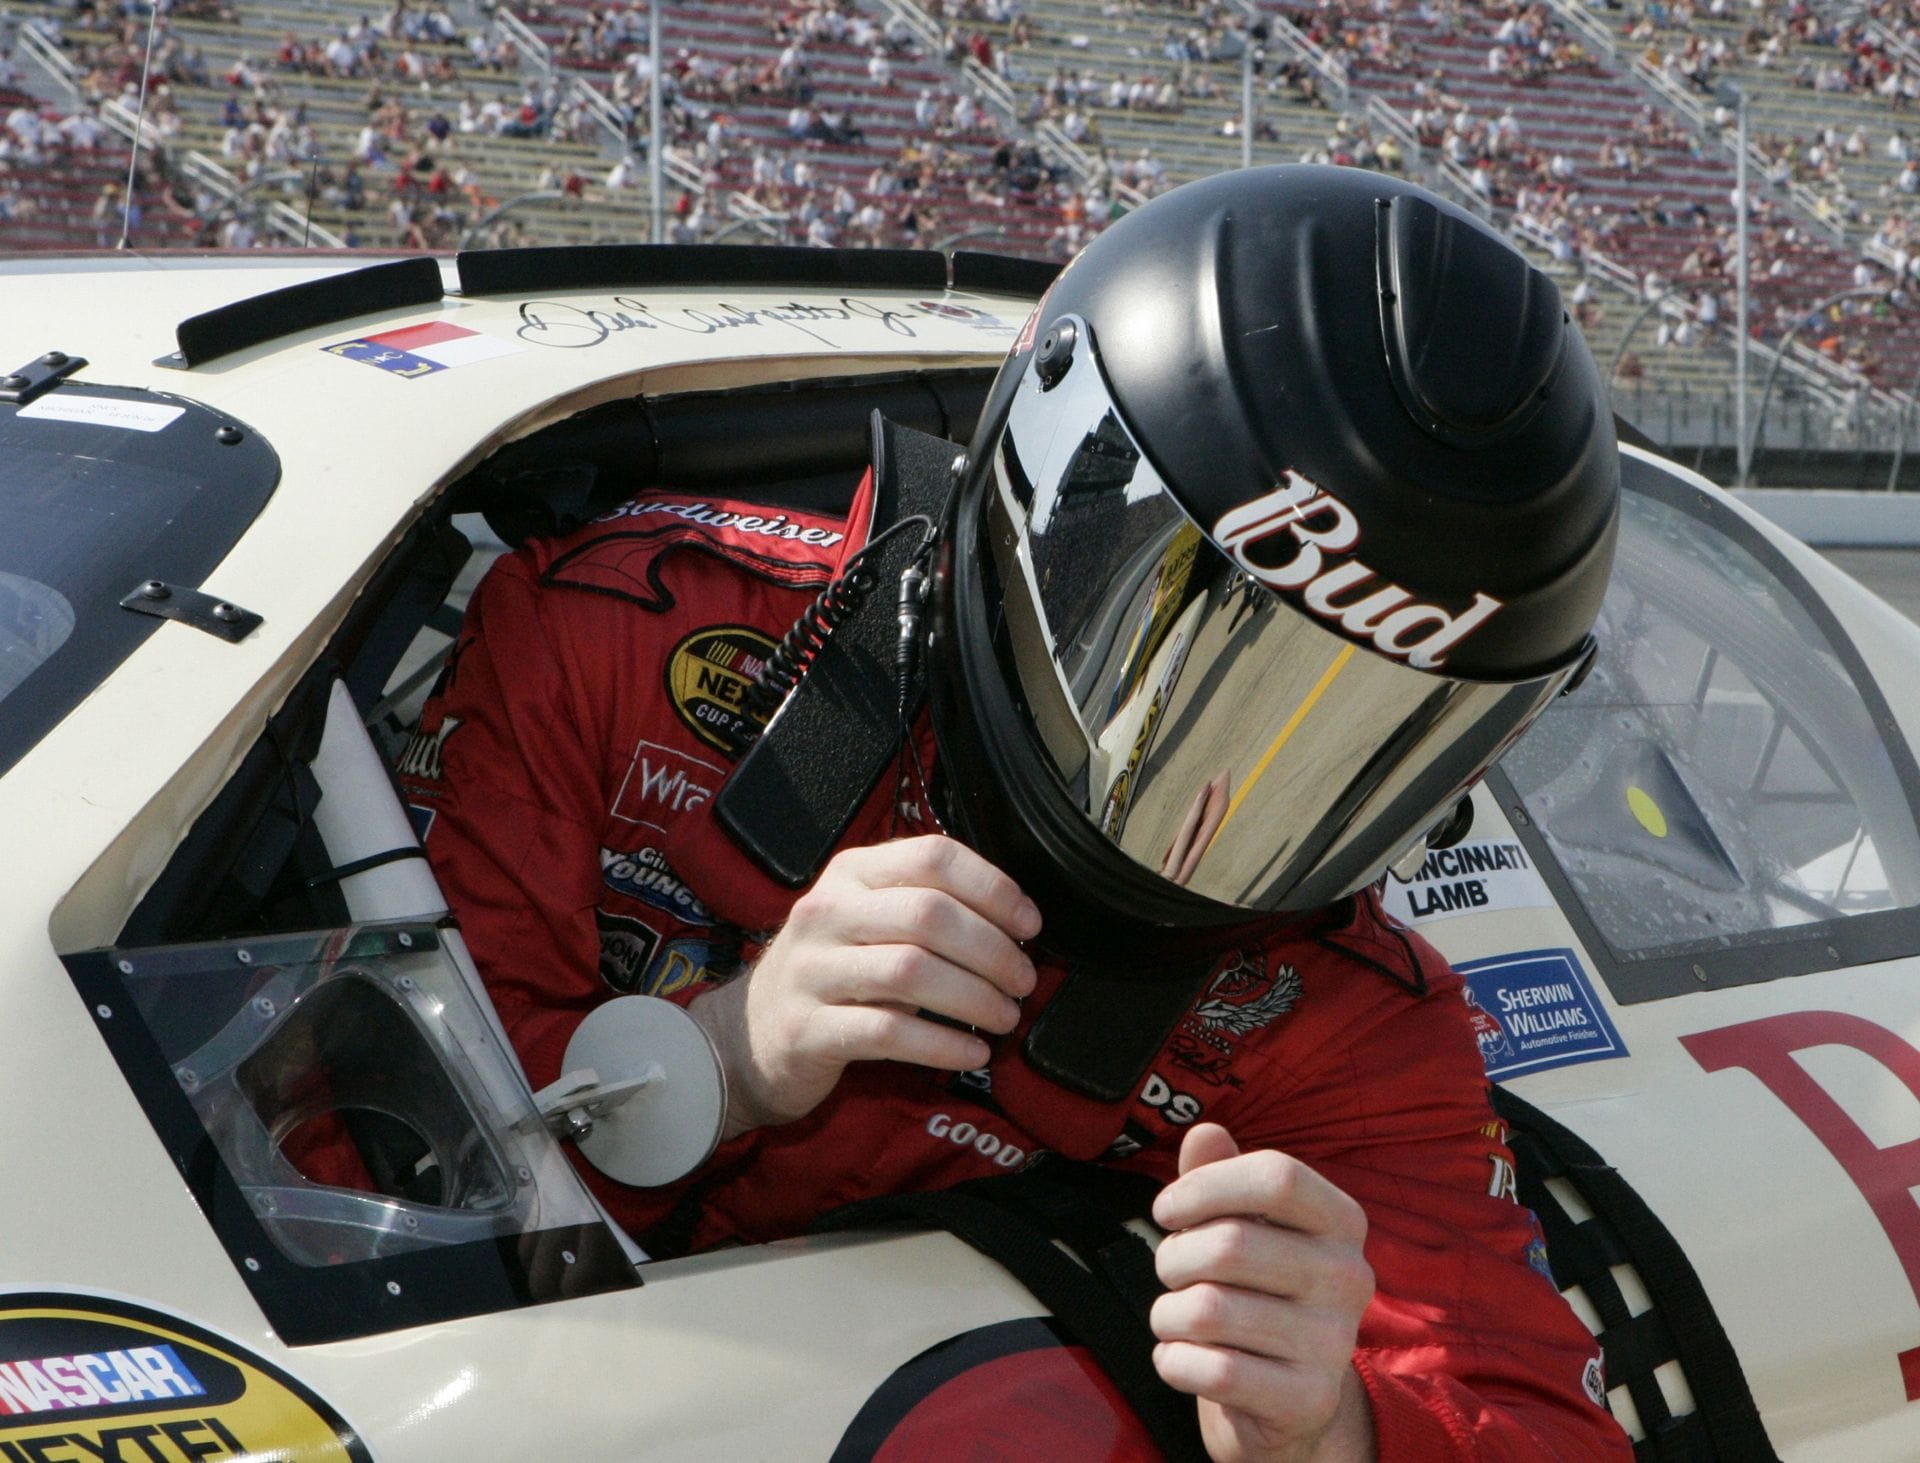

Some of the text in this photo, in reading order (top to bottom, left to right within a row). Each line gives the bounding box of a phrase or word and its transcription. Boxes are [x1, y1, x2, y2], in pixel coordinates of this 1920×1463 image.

[1213, 465, 1504, 674] Bud
[696, 704, 730, 727] CUP
[601, 848, 694, 905] YOUNG
[1412, 845, 1528, 882] NCINNATI
[1407, 880, 1489, 918] LAMB
[1497, 983, 1575, 1012] SHERWIN
[1505, 1007, 1588, 1037] WILLIAMS
[1521, 1029, 1598, 1051] Automotive Finishes
[926, 1113, 1025, 1168] GOOD
[0, 1346, 194, 1415] NASCAR
